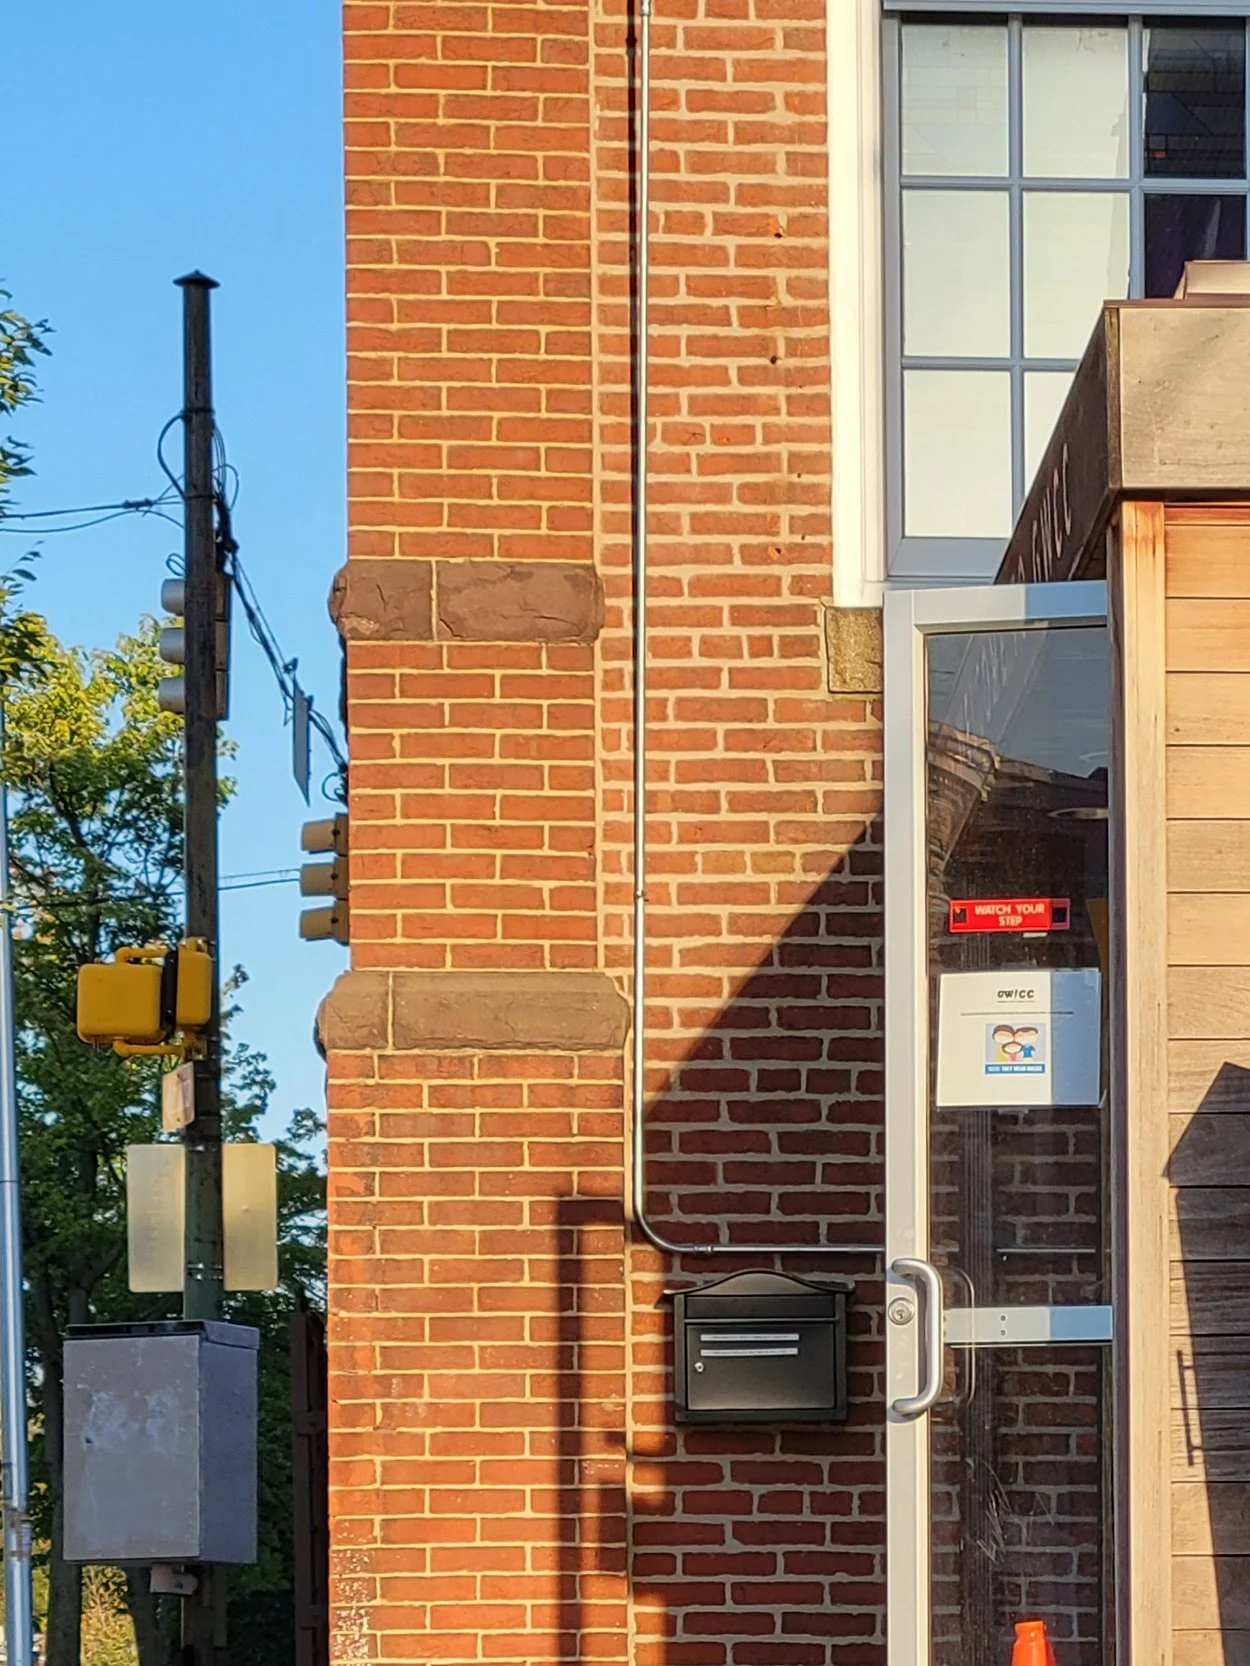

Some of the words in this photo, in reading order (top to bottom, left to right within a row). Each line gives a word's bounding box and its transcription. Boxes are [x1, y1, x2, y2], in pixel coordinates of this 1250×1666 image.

[975, 904, 1011, 915] WATCH
[1015, 903, 1045, 914] YOUR
[998, 916, 1023, 926] STEP
